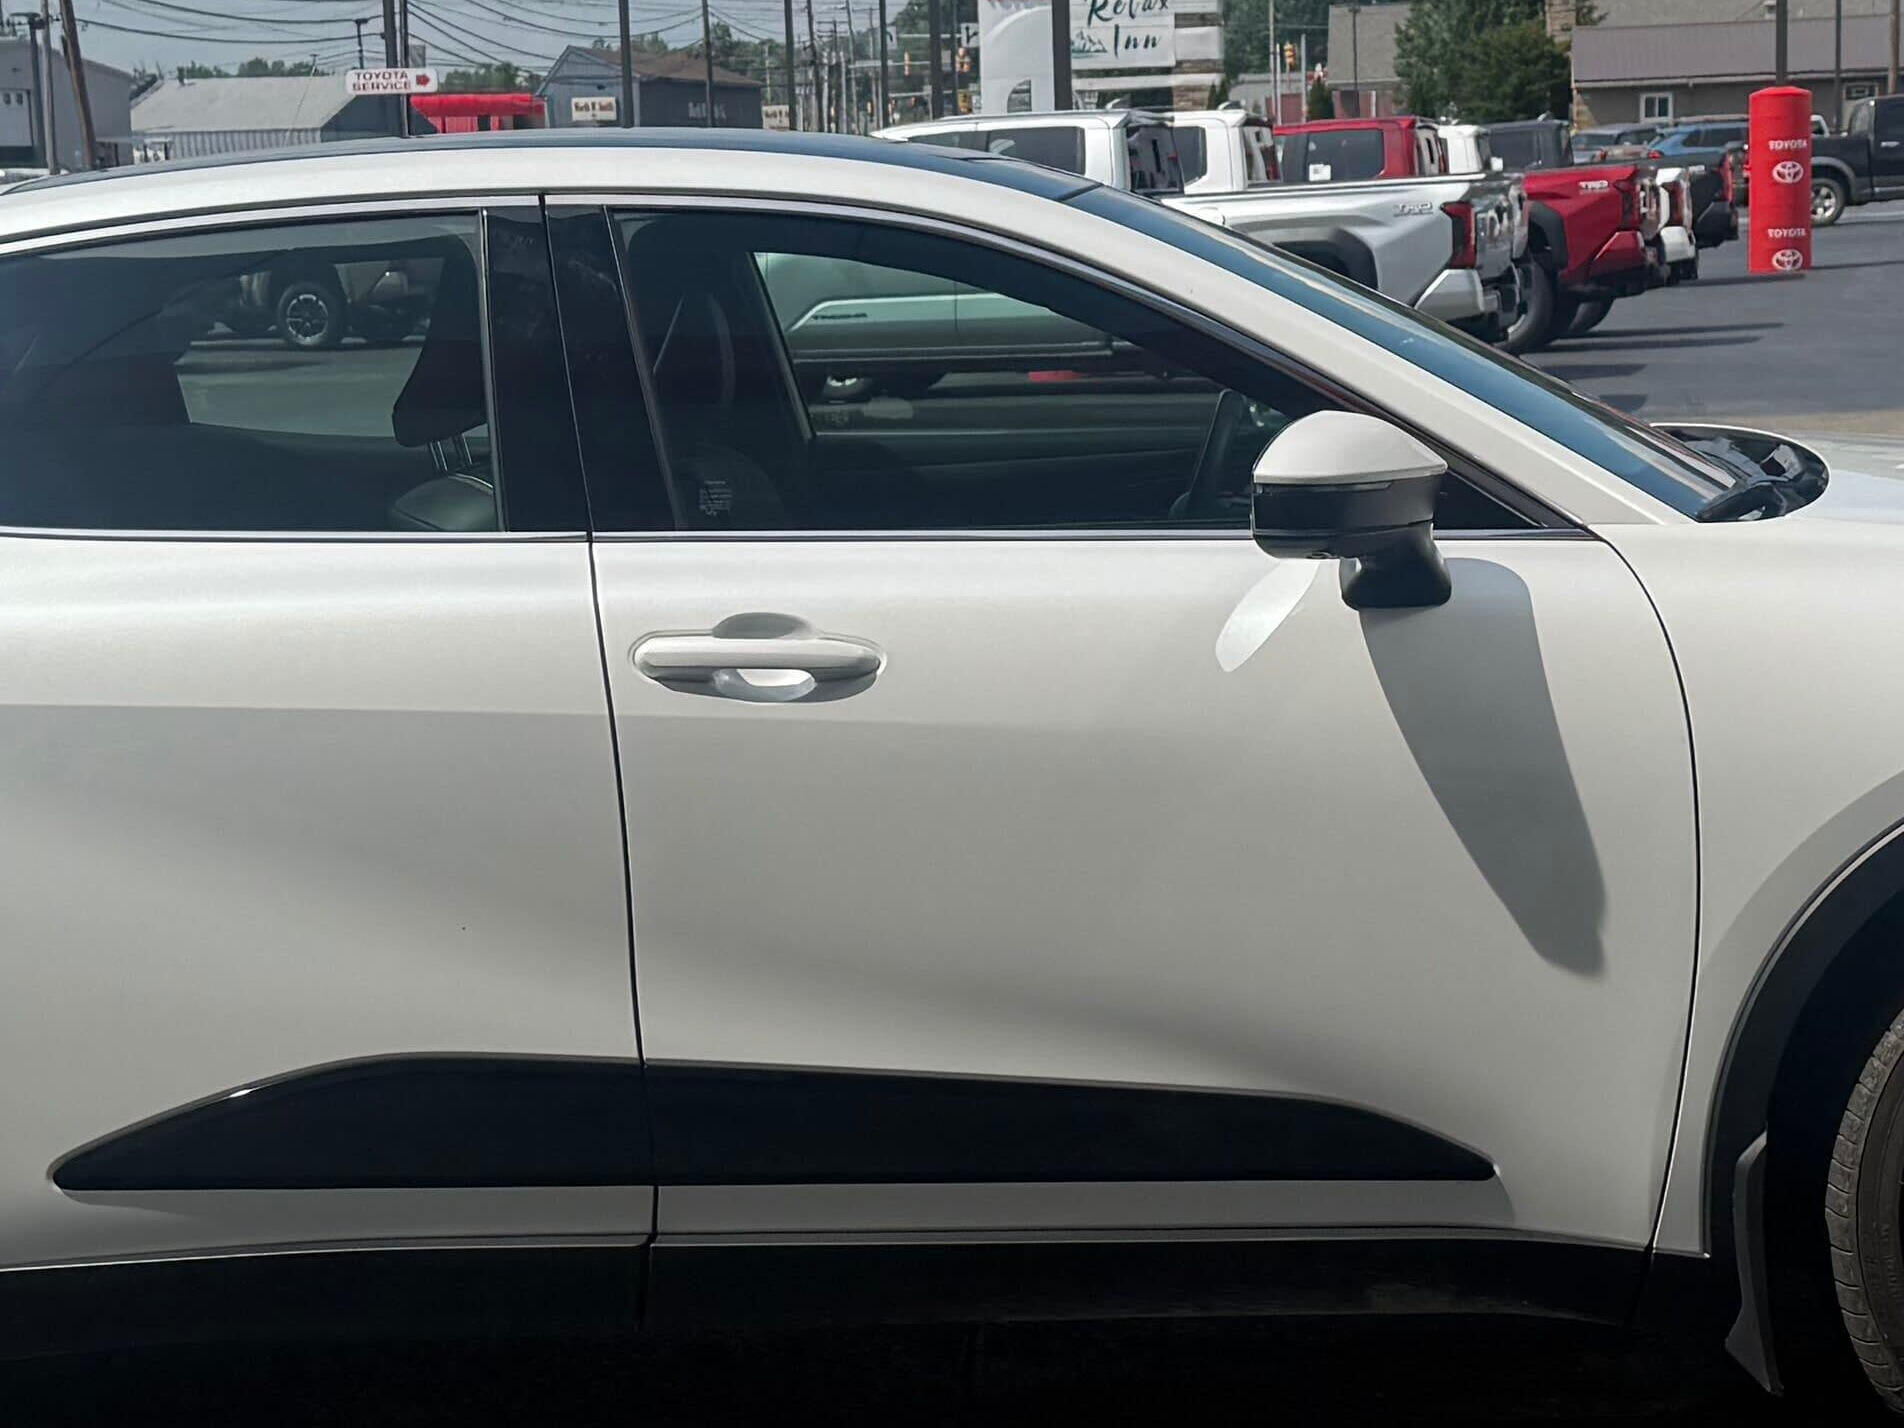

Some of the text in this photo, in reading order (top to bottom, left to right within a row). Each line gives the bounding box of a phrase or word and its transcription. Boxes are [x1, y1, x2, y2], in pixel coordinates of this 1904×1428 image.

[1113, 23, 1162, 60] Inn
[354, 71, 409, 81] TOYOTA
[352, 82, 412, 92] SERVICE
[1768, 139, 1808, 150] TOYOTA
[1767, 227, 1807, 238] TOYOTA
